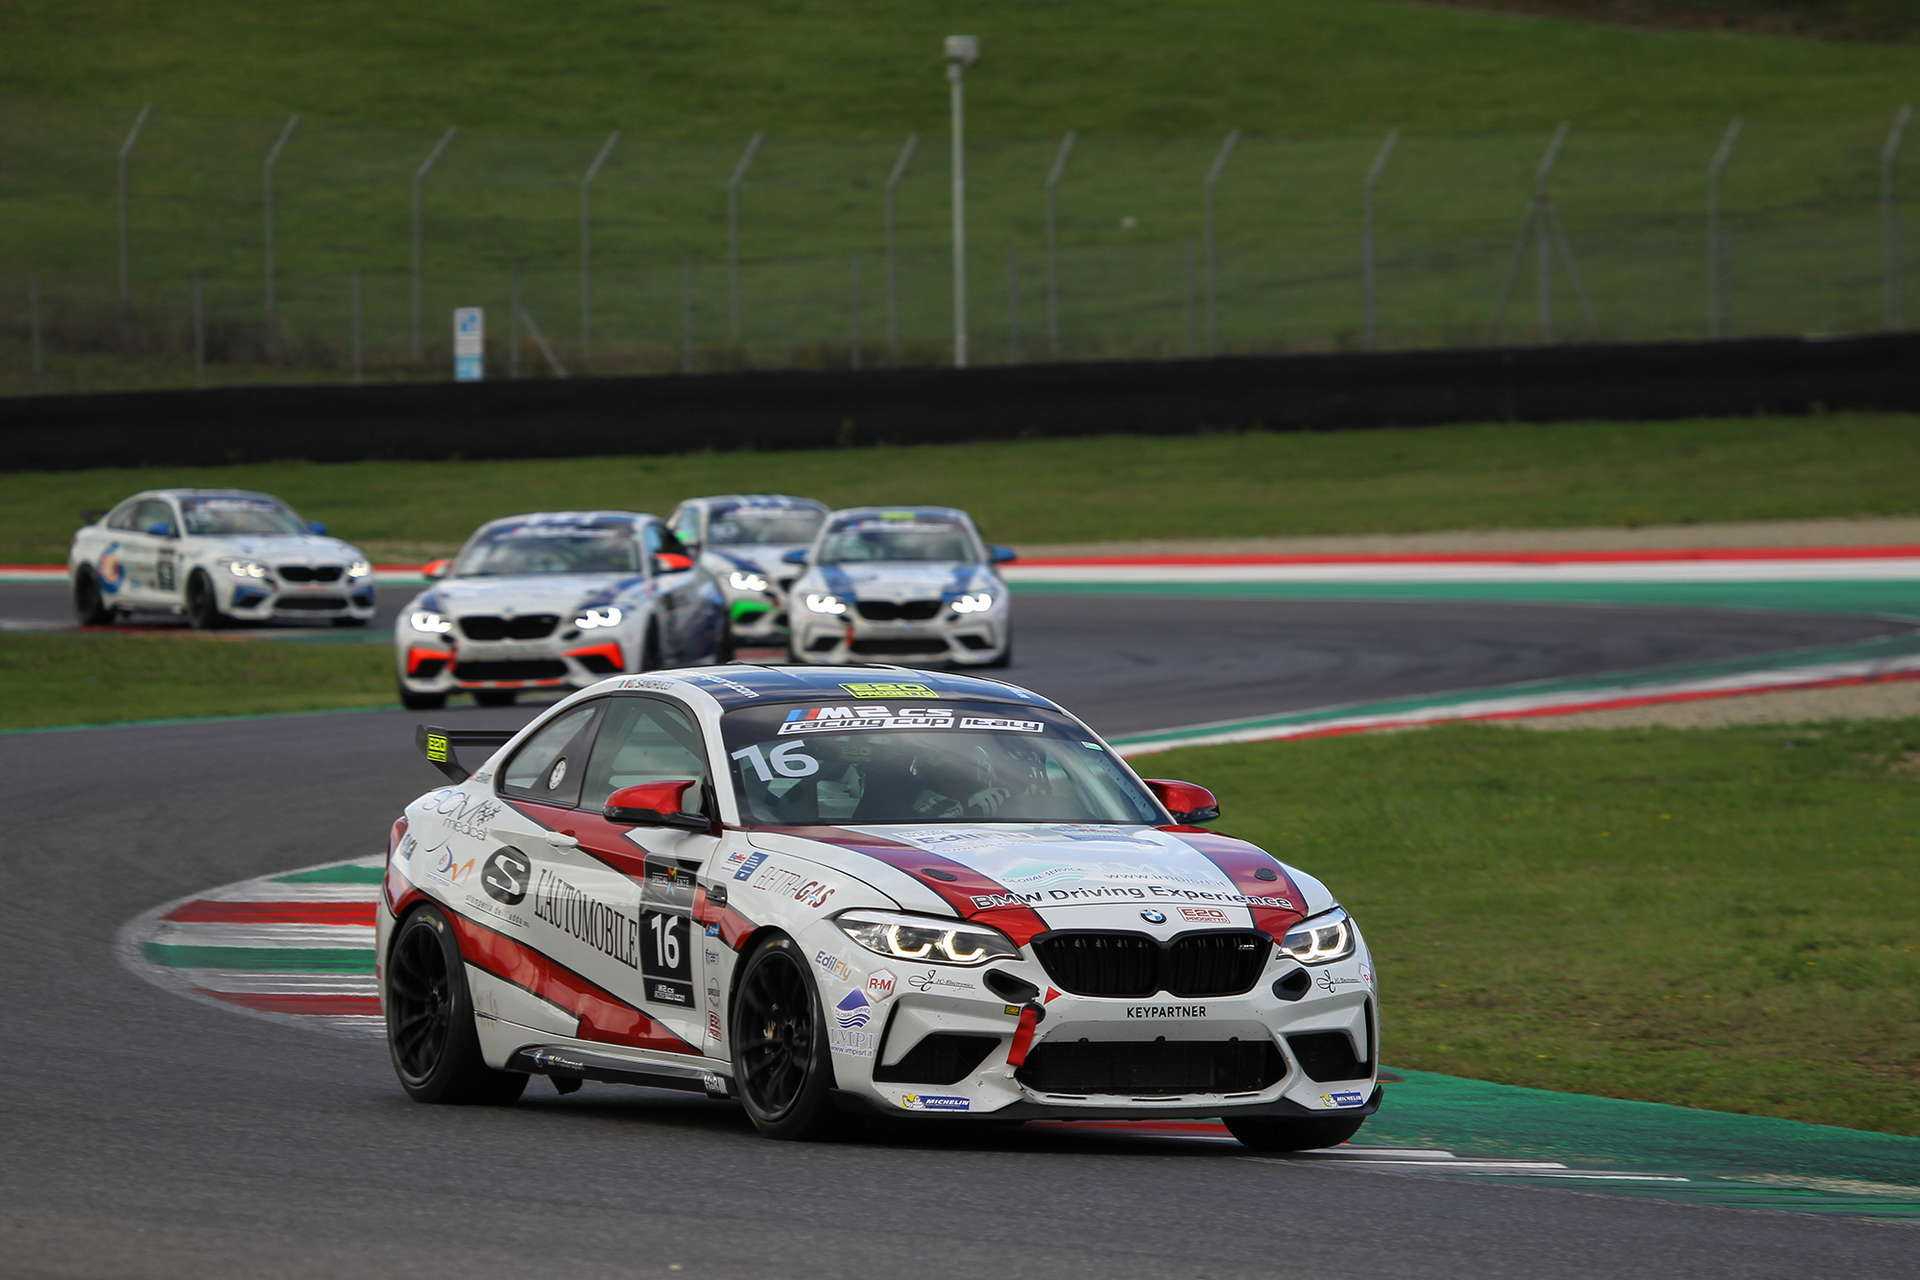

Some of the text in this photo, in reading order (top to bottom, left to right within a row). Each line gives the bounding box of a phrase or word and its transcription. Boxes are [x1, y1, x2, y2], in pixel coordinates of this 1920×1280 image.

[894, 717, 951, 729] cup
[732, 739, 819, 782] 16
[971, 885, 1294, 910] BMW Driving Experience
[534, 868, 638, 970] L'AUTOMOBILE
[1181, 909, 1225, 918] E20
[651, 913, 680, 969] 16
[869, 977, 893, 991] R-M
[1126, 1005, 1206, 1018] KEYPARTNER
